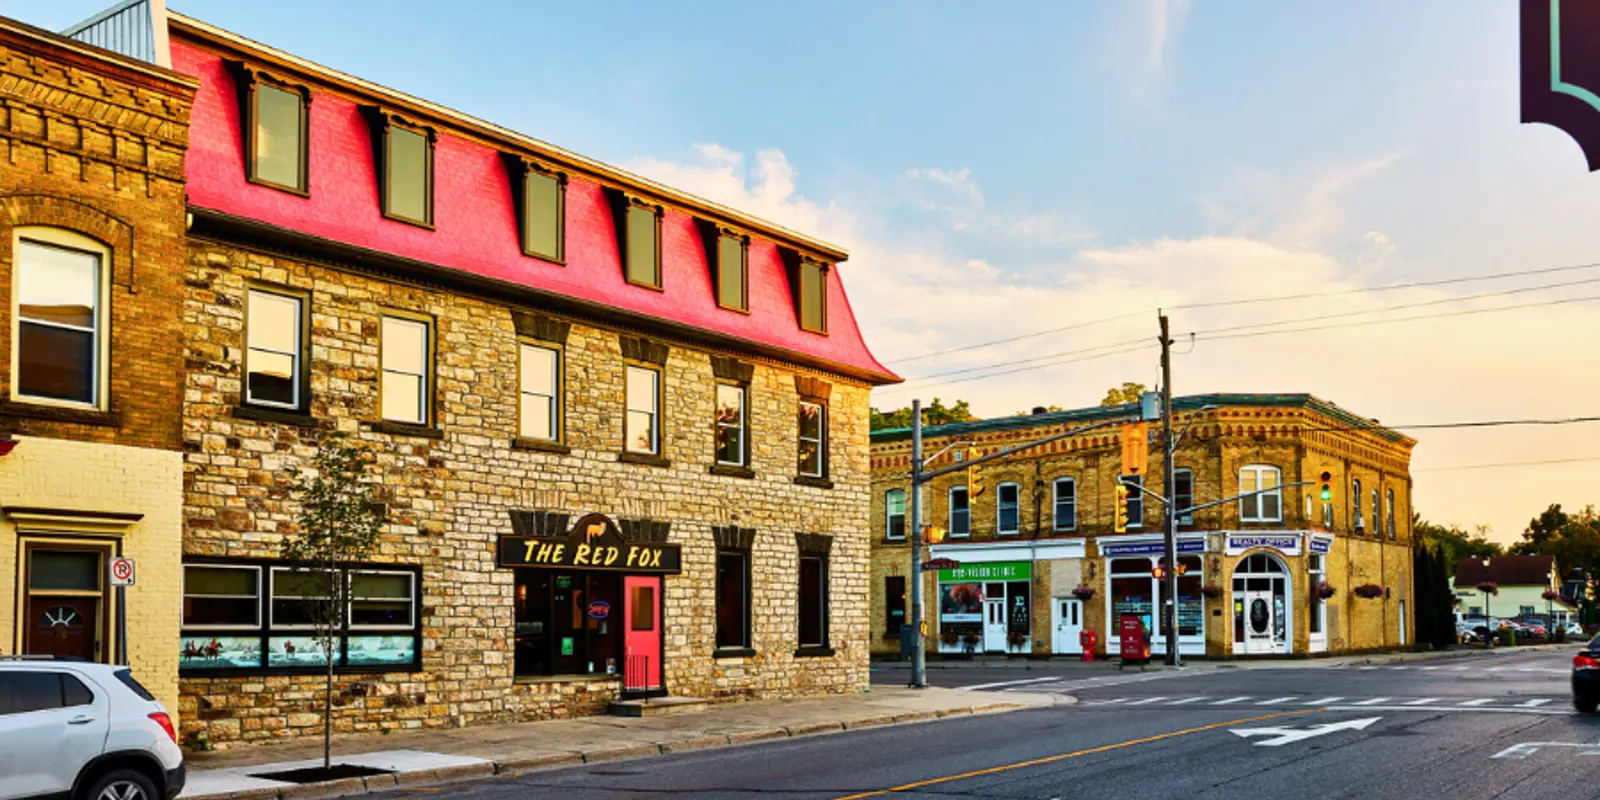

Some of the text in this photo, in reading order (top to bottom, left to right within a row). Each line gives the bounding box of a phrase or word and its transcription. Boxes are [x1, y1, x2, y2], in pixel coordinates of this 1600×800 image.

[524, 540, 662, 567] THE RED FOX
